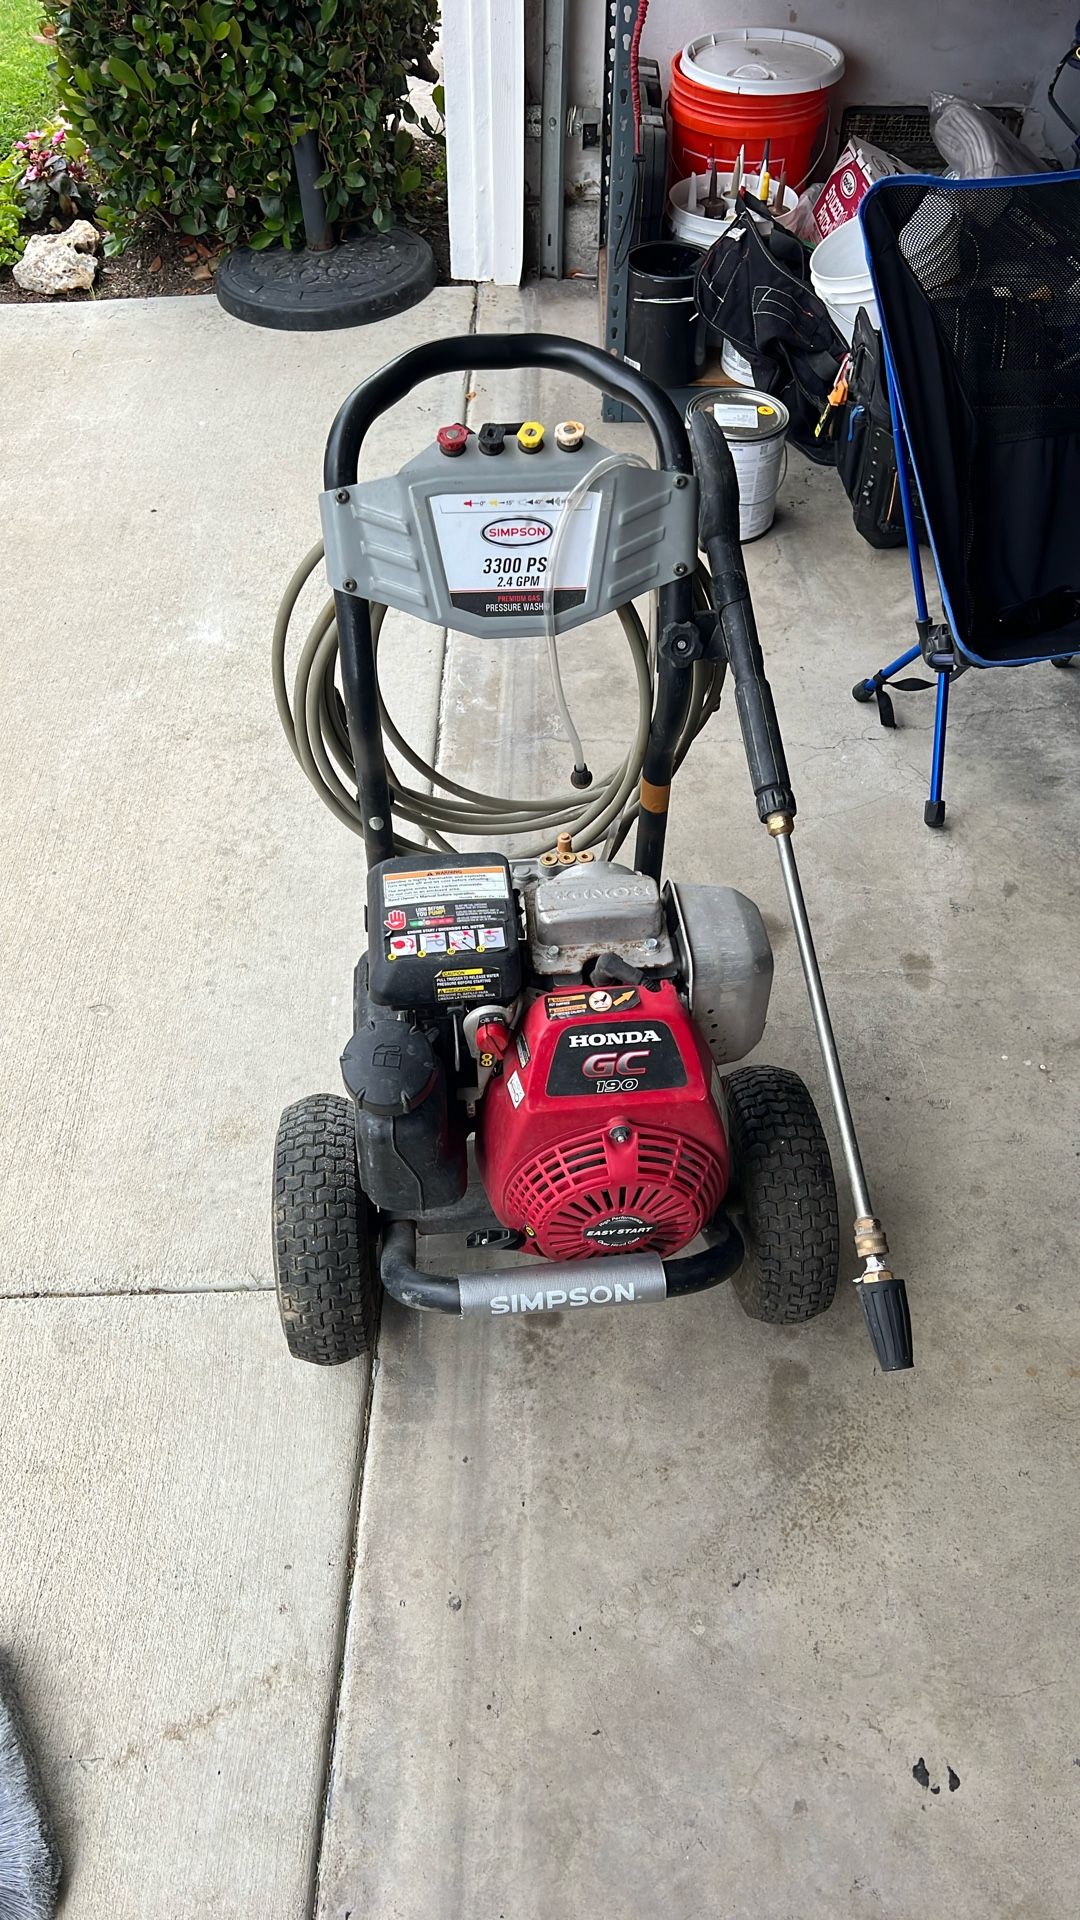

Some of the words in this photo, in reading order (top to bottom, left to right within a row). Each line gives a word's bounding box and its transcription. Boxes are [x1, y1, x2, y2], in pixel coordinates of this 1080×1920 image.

[488, 527, 547, 537] SIMPSON
[483, 557, 522, 574] 3300
[497, 576, 513, 587] 2.4
[516, 576, 540, 587] GPM
[528, 594, 541, 602] GAS
[485, 603, 521, 612] PRESSURE
[568, 1030, 662, 1048] HONDA
[581, 1050, 651, 1078] GC
[596, 1078, 639, 1093] 190
[616, 1226, 653, 1235] START
[489, 1282, 636, 1315] SIMPSON
